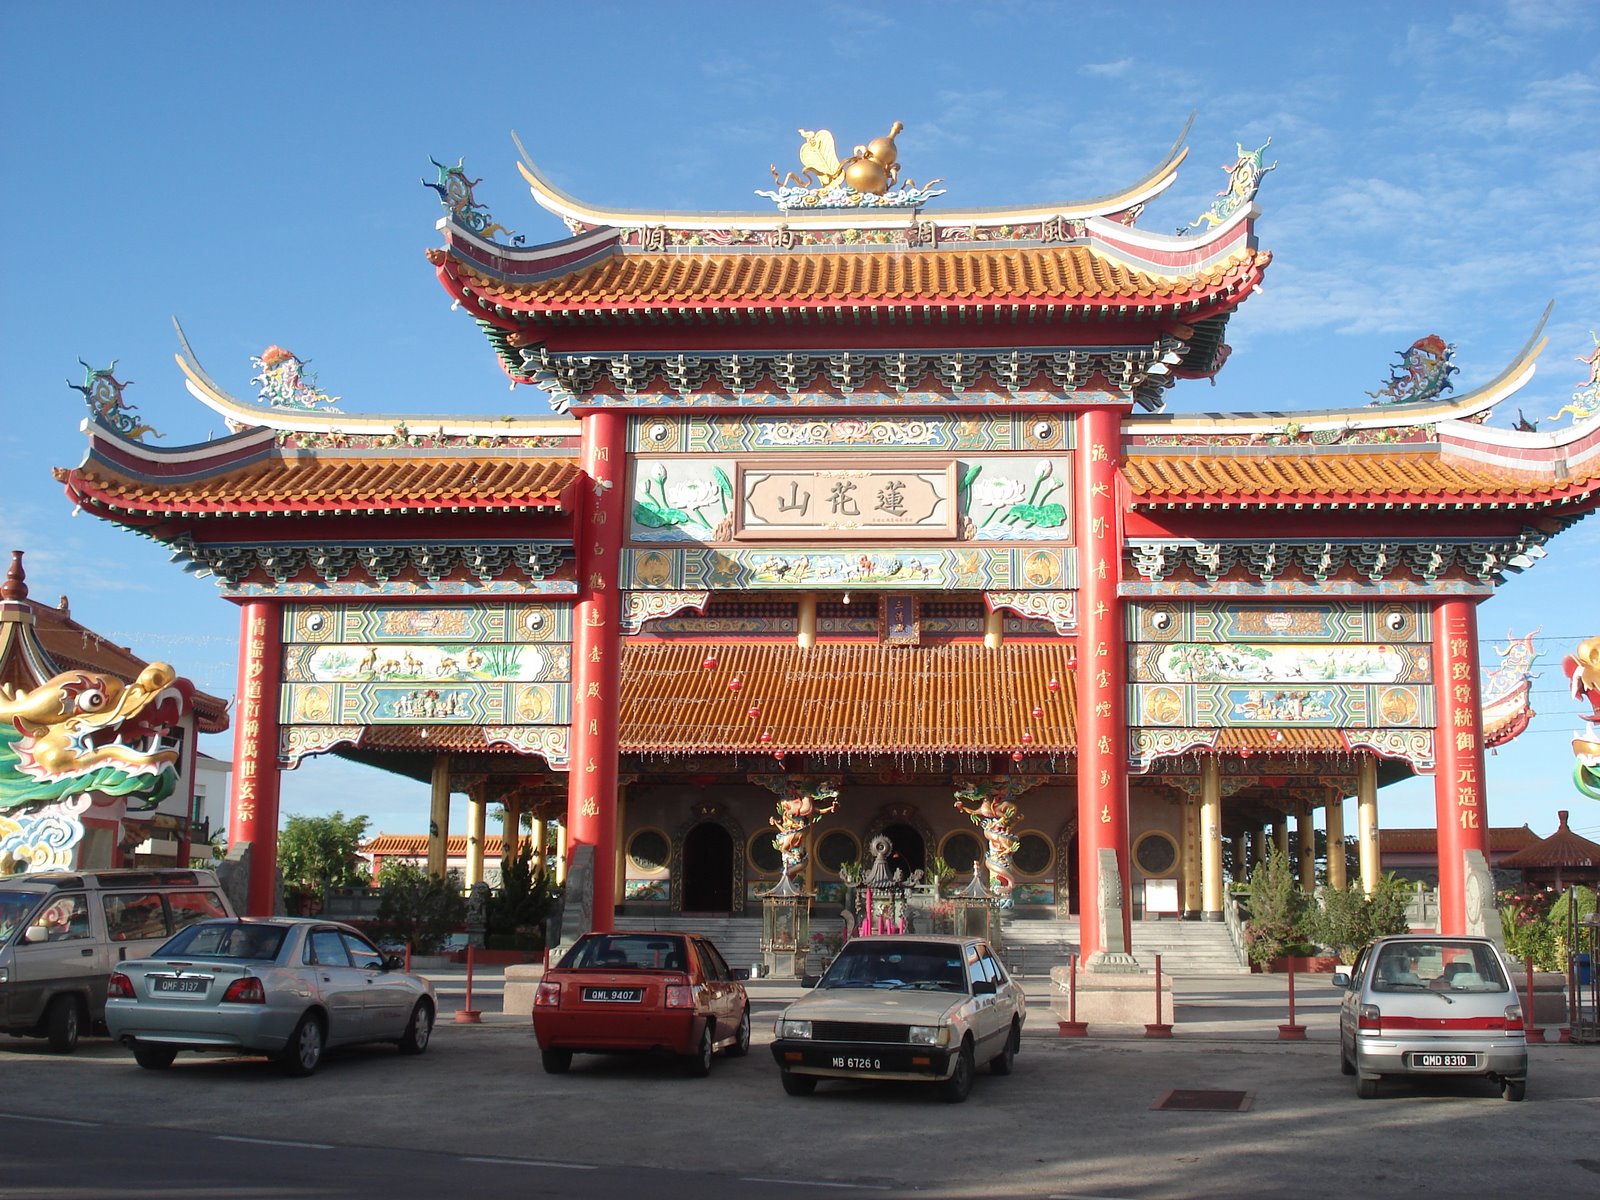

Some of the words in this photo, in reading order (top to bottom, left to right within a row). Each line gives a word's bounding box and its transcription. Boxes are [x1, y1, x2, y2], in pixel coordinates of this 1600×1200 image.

[162, 981, 178, 991] QMF
[180, 981, 199, 992] 3137
[592, 991, 608, 1000] QML
[611, 991, 634, 1000] 9407
[832, 1057, 845, 1068] MB
[847, 1058, 872, 1069] 6726
[874, 1059, 881, 1070] Q
[1423, 1055, 1442, 1066] QMD
[1444, 1055, 1467, 1066] 8310
